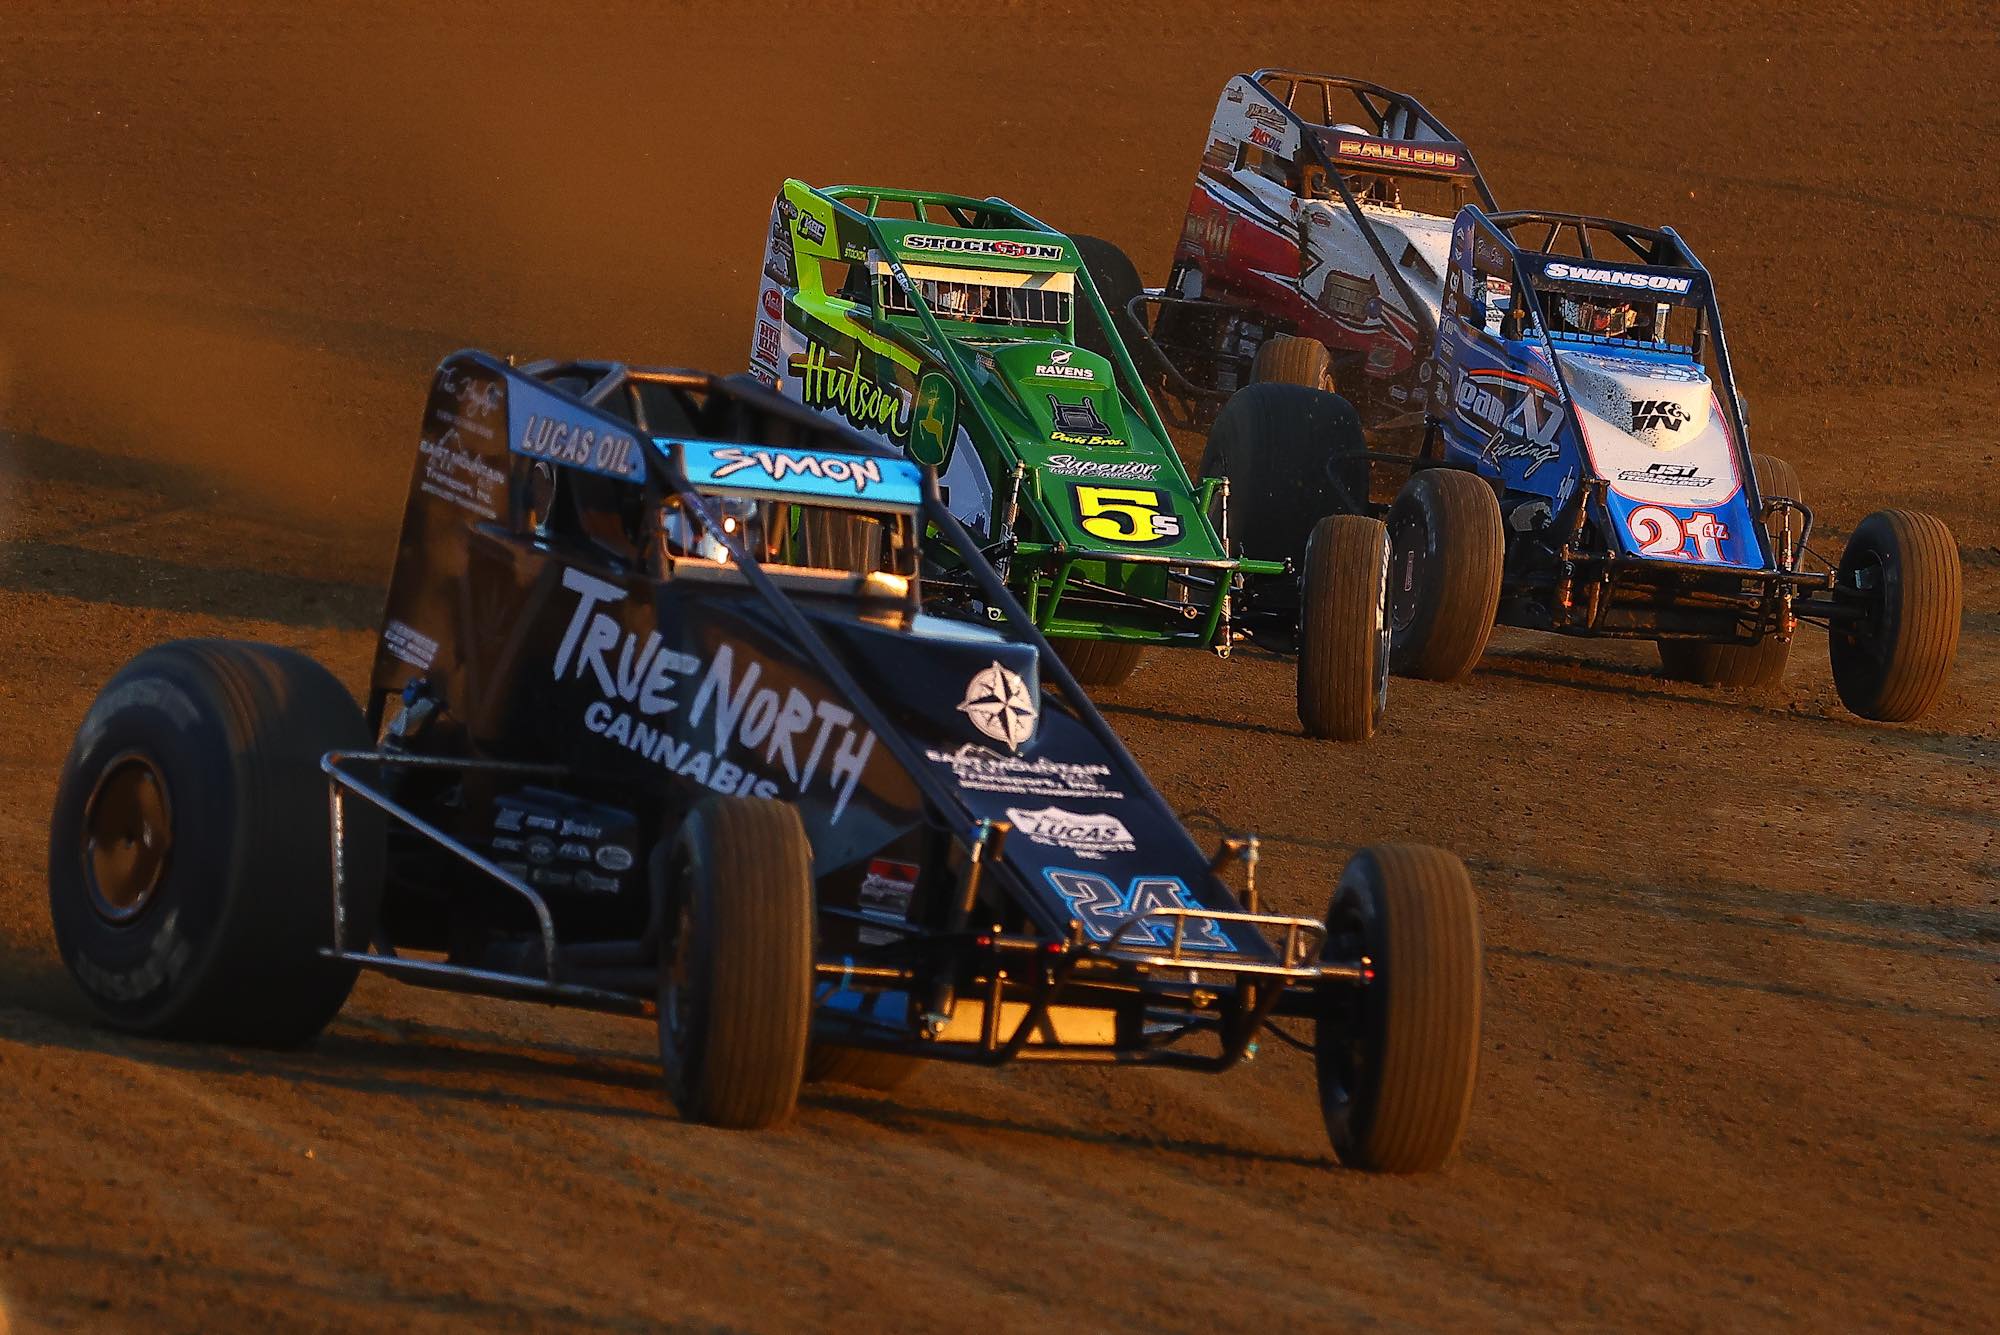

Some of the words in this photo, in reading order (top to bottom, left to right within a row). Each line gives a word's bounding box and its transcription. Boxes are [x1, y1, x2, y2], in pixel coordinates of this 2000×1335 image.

[1339, 140, 1457, 167] BALLOU
[1545, 263, 1689, 293] SWANSON
[791, 341, 910, 438] Hutson
[1035, 365, 1094, 379] RAVENS
[521, 415, 593, 465] LUCAS
[596, 434, 634, 474] OIL
[1050, 431, 1086, 445] Davis
[1087, 436, 1125, 446] Bros.
[1481, 429, 1560, 479] Racing
[711, 448, 882, 493] SIMON
[1040, 454, 1162, 476] Superior
[1649, 465, 1696, 477] JST
[552, 565, 702, 715] TRUE
[688, 644, 877, 827] NORTH
[583, 702, 781, 801] CANNABIS
